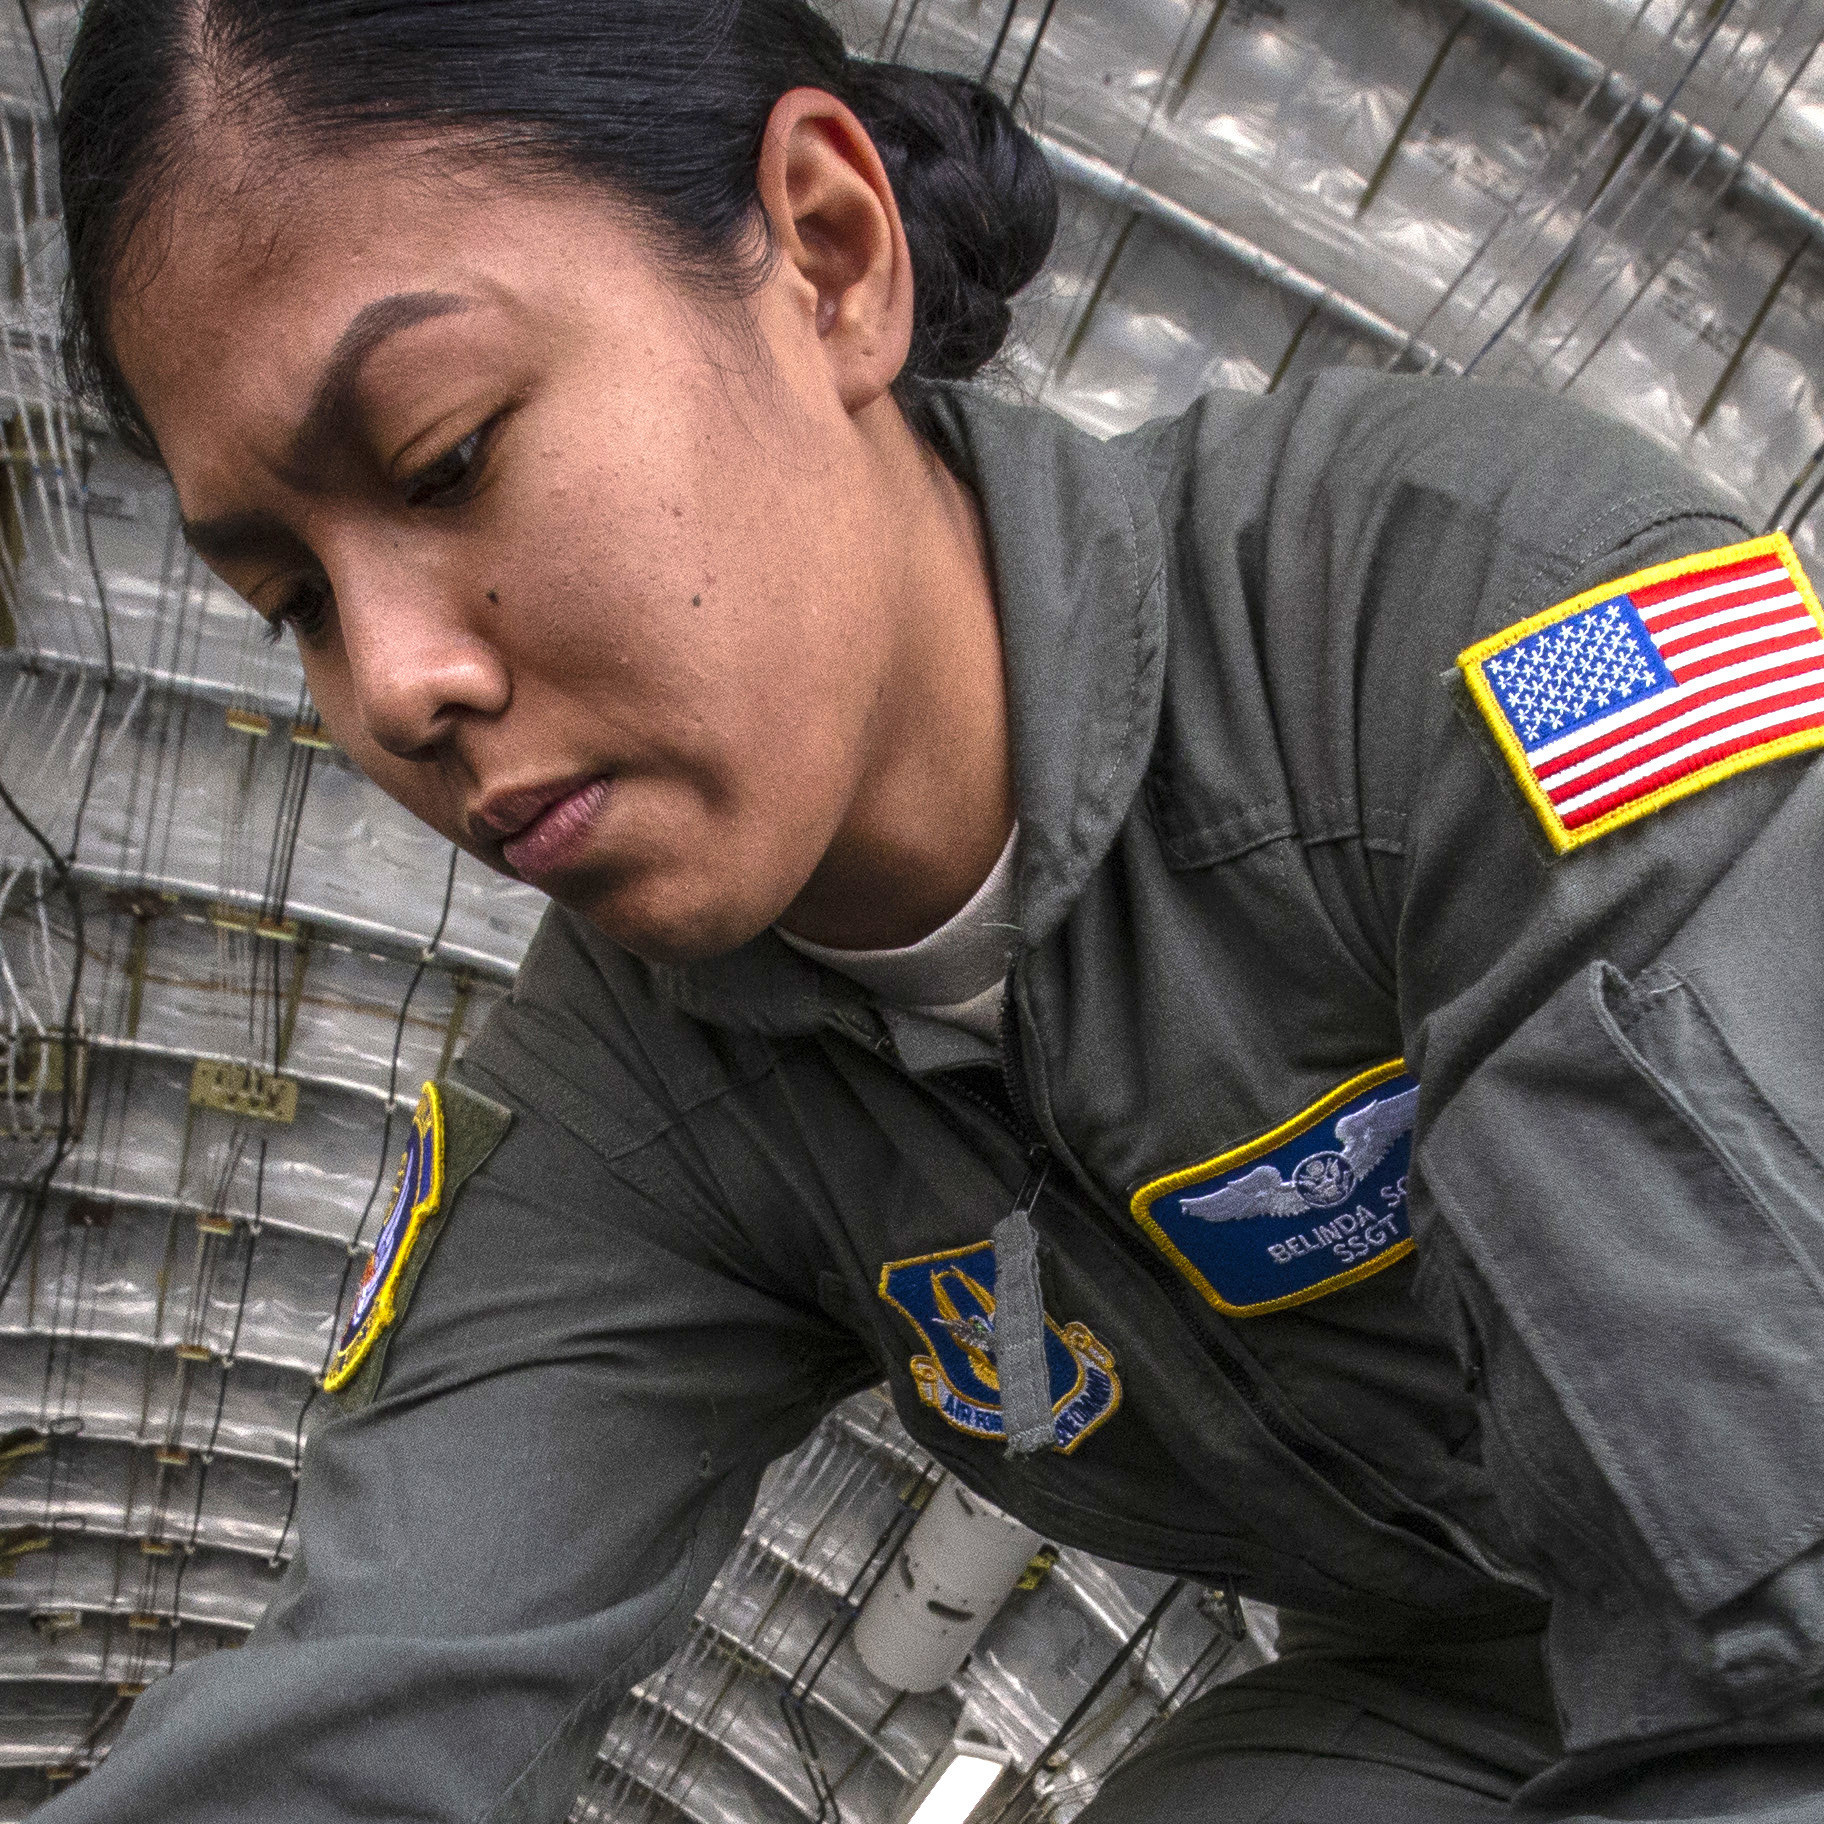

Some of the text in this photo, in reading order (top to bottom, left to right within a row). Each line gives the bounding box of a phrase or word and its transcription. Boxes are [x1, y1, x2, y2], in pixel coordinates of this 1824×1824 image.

[1267, 1205, 1378, 1265] BELINDA
[1333, 1213, 1399, 1264] SSGT
[943, 1393, 973, 1424] AIR
[973, 1409, 1005, 1433] FOR
